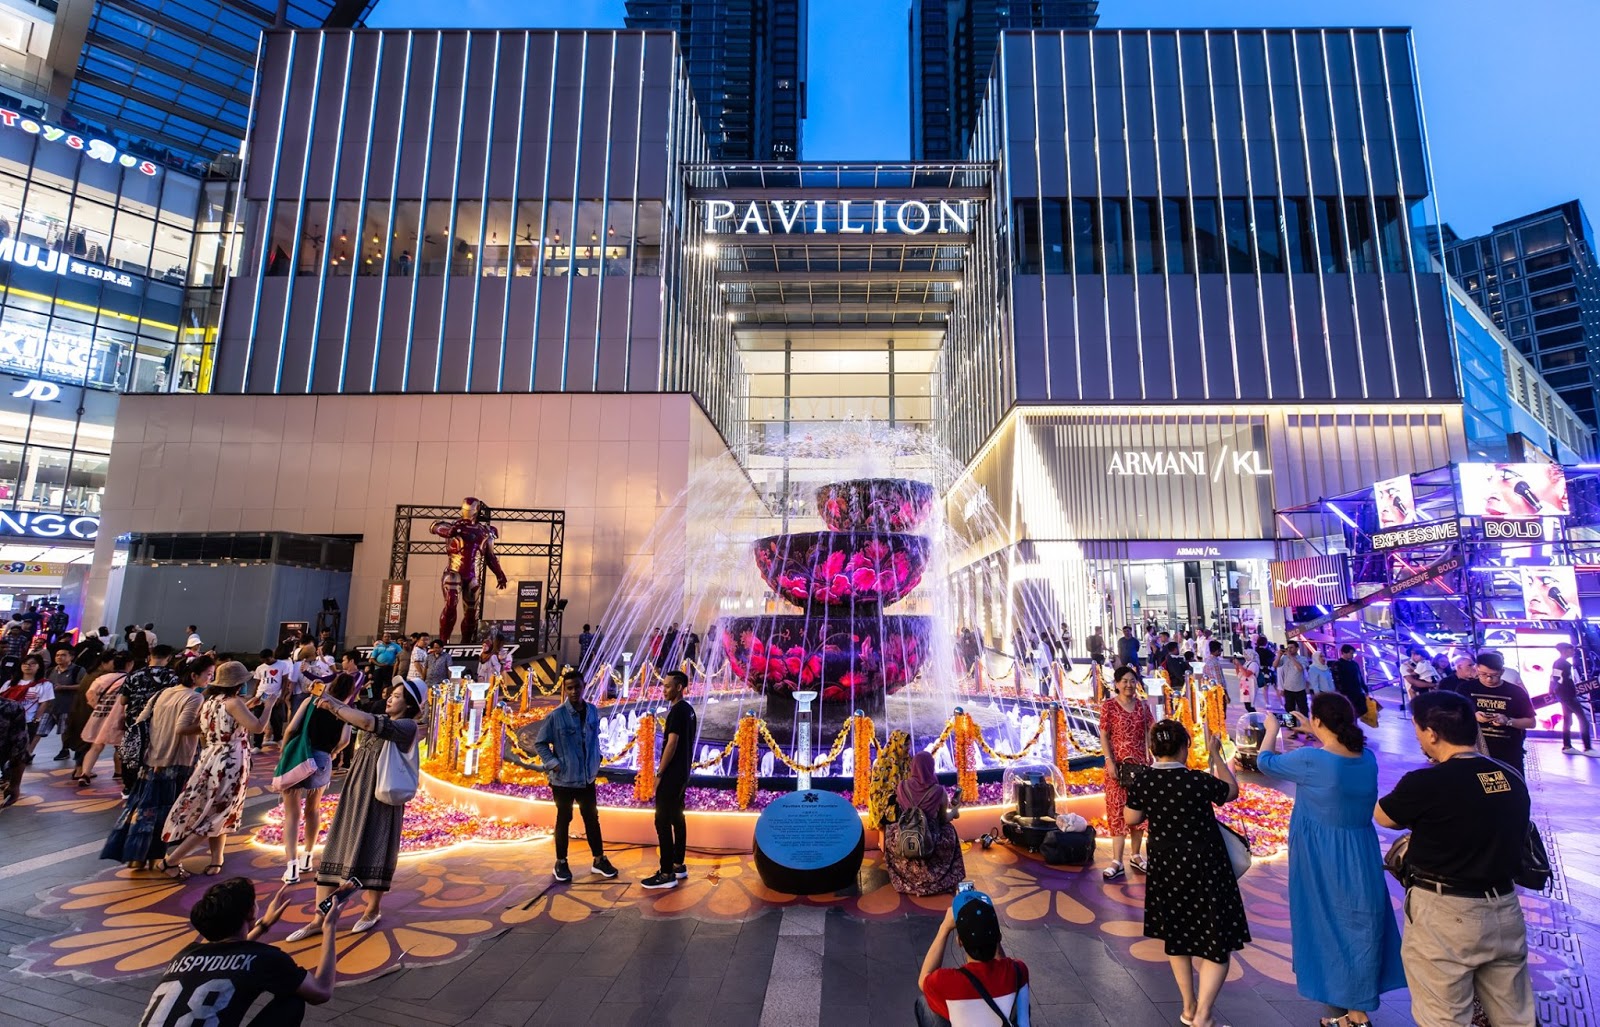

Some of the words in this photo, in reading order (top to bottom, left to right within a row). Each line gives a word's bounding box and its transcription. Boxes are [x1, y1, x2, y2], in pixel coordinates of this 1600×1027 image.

[705, 199, 970, 234] PAVILION
[0, 237, 70, 276] MUJI
[71, 261, 132, 288] 無印良品
[12, 379, 60, 401] JD
[1107, 451, 1206, 476] ARMANI
[1232, 450, 1272, 476] KL
[1371, 521, 1459, 549] EXPRESSIVE
[1484, 521, 1543, 538] BOLD
[1176, 547, 1203, 556] ARMANI
[1390, 571, 1429, 594] EXPRESSIVE
[1437, 559, 1458, 574] BOLD
